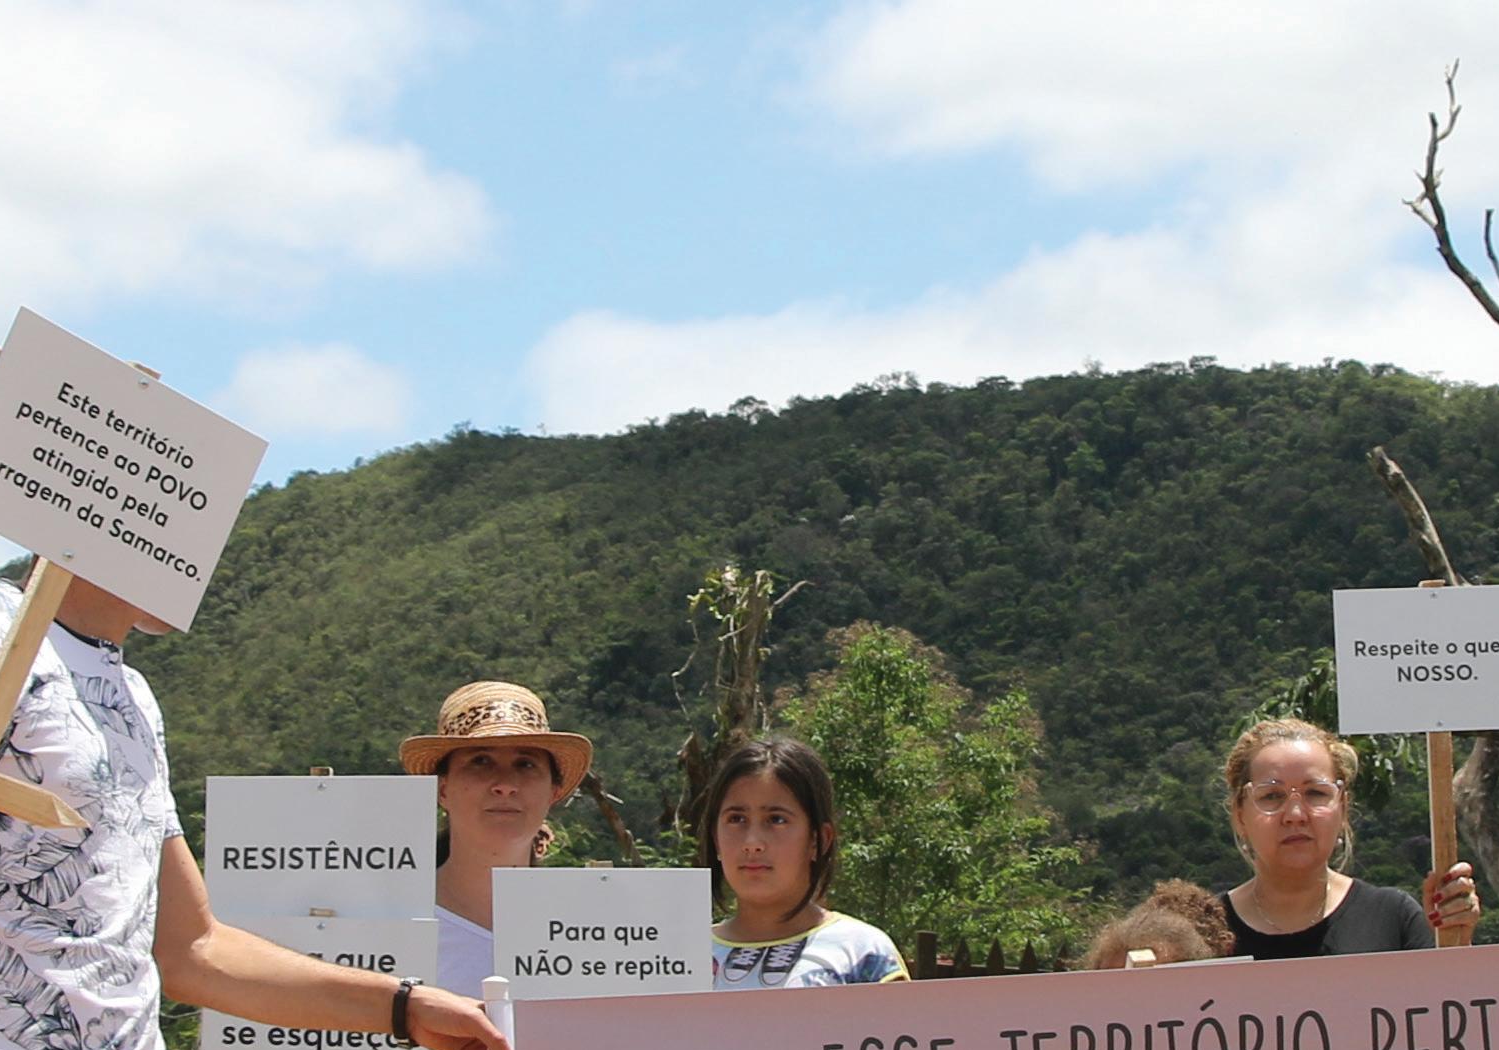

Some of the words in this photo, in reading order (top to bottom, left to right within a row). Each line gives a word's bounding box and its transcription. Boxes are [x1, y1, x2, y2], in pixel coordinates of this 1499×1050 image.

[58, 383, 100, 418] Este
[106, 410, 193, 469] território
[16, 403, 108, 459] pertence
[114, 455, 140, 475] ao
[145, 466, 207, 510] POVO
[33, 447, 118, 499] atingido
[121, 495, 168, 527] pela
[77, 504, 104, 528] da
[109, 519, 200, 581] Samarco.
[1355, 640, 1439, 659] Respeite
[1446, 643, 1458, 654] o
[1398, 665, 1477, 682] NOSSO.
[224, 841, 416, 869] RESISTÊNCIA
[550, 921, 605, 941] Para
[614, 927, 658, 946] que
[516, 949, 572, 976] NÃO
[582, 961, 606, 975] se
[616, 955, 691, 980] repita.
[222, 1026, 256, 1045] se
